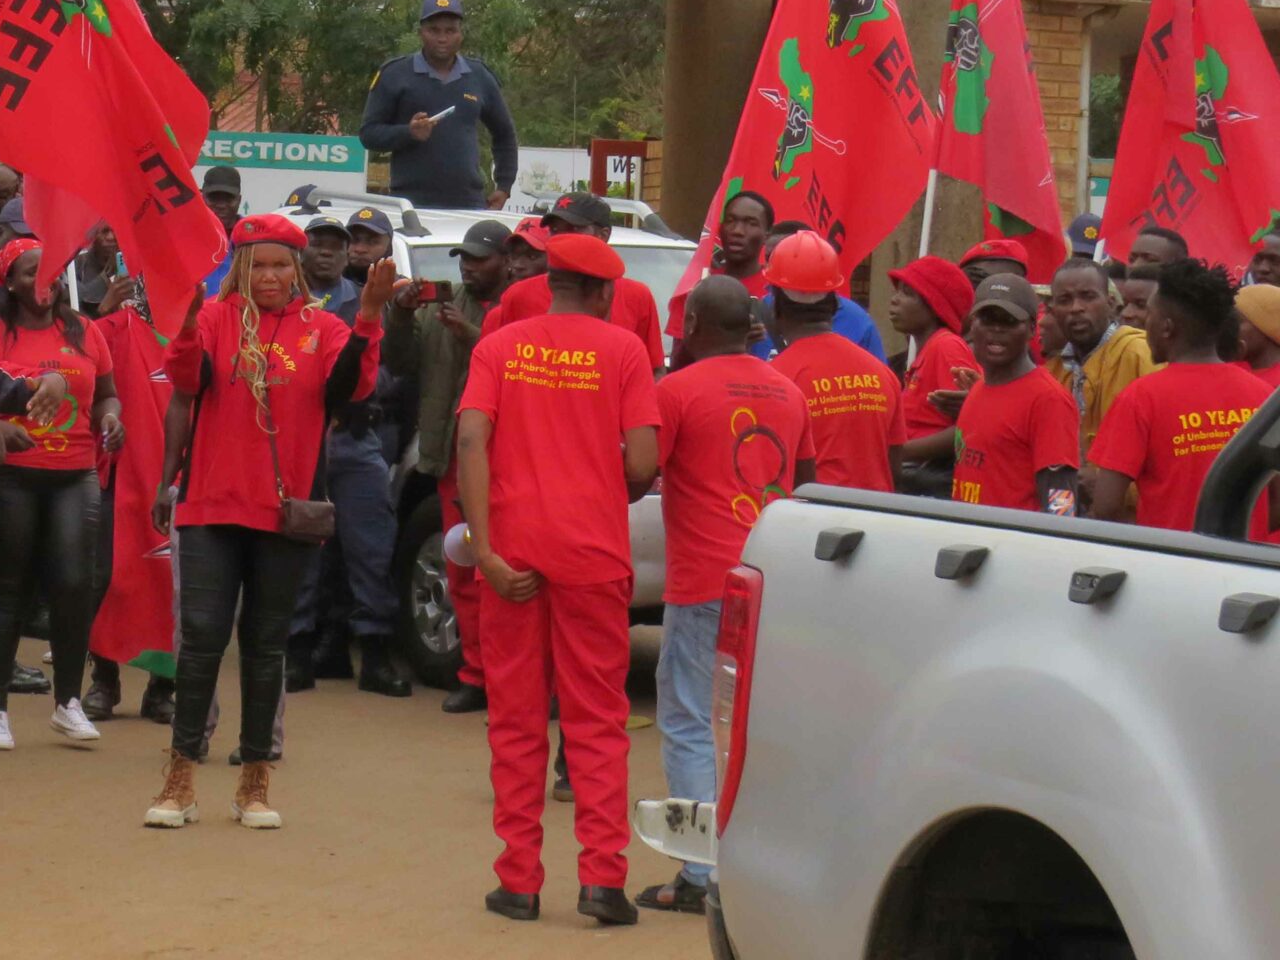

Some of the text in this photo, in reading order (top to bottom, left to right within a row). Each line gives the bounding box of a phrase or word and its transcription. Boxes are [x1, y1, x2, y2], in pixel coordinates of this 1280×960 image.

[200, 139, 349, 163] RECTIONS
[515, 343, 596, 366] 10 YEARS
[561, 368, 601, 381] Struggle
[812, 374, 881, 394] 10 YEARS
[819, 393, 857, 405] Unbroken
[823, 404, 857, 417] Economic
[1178, 407, 1259, 429] 10 YEAR
[1172, 433, 1185, 445] Of
[1187, 429, 1231, 441] Unbroken
[1174, 441, 1225, 457] For Econom
